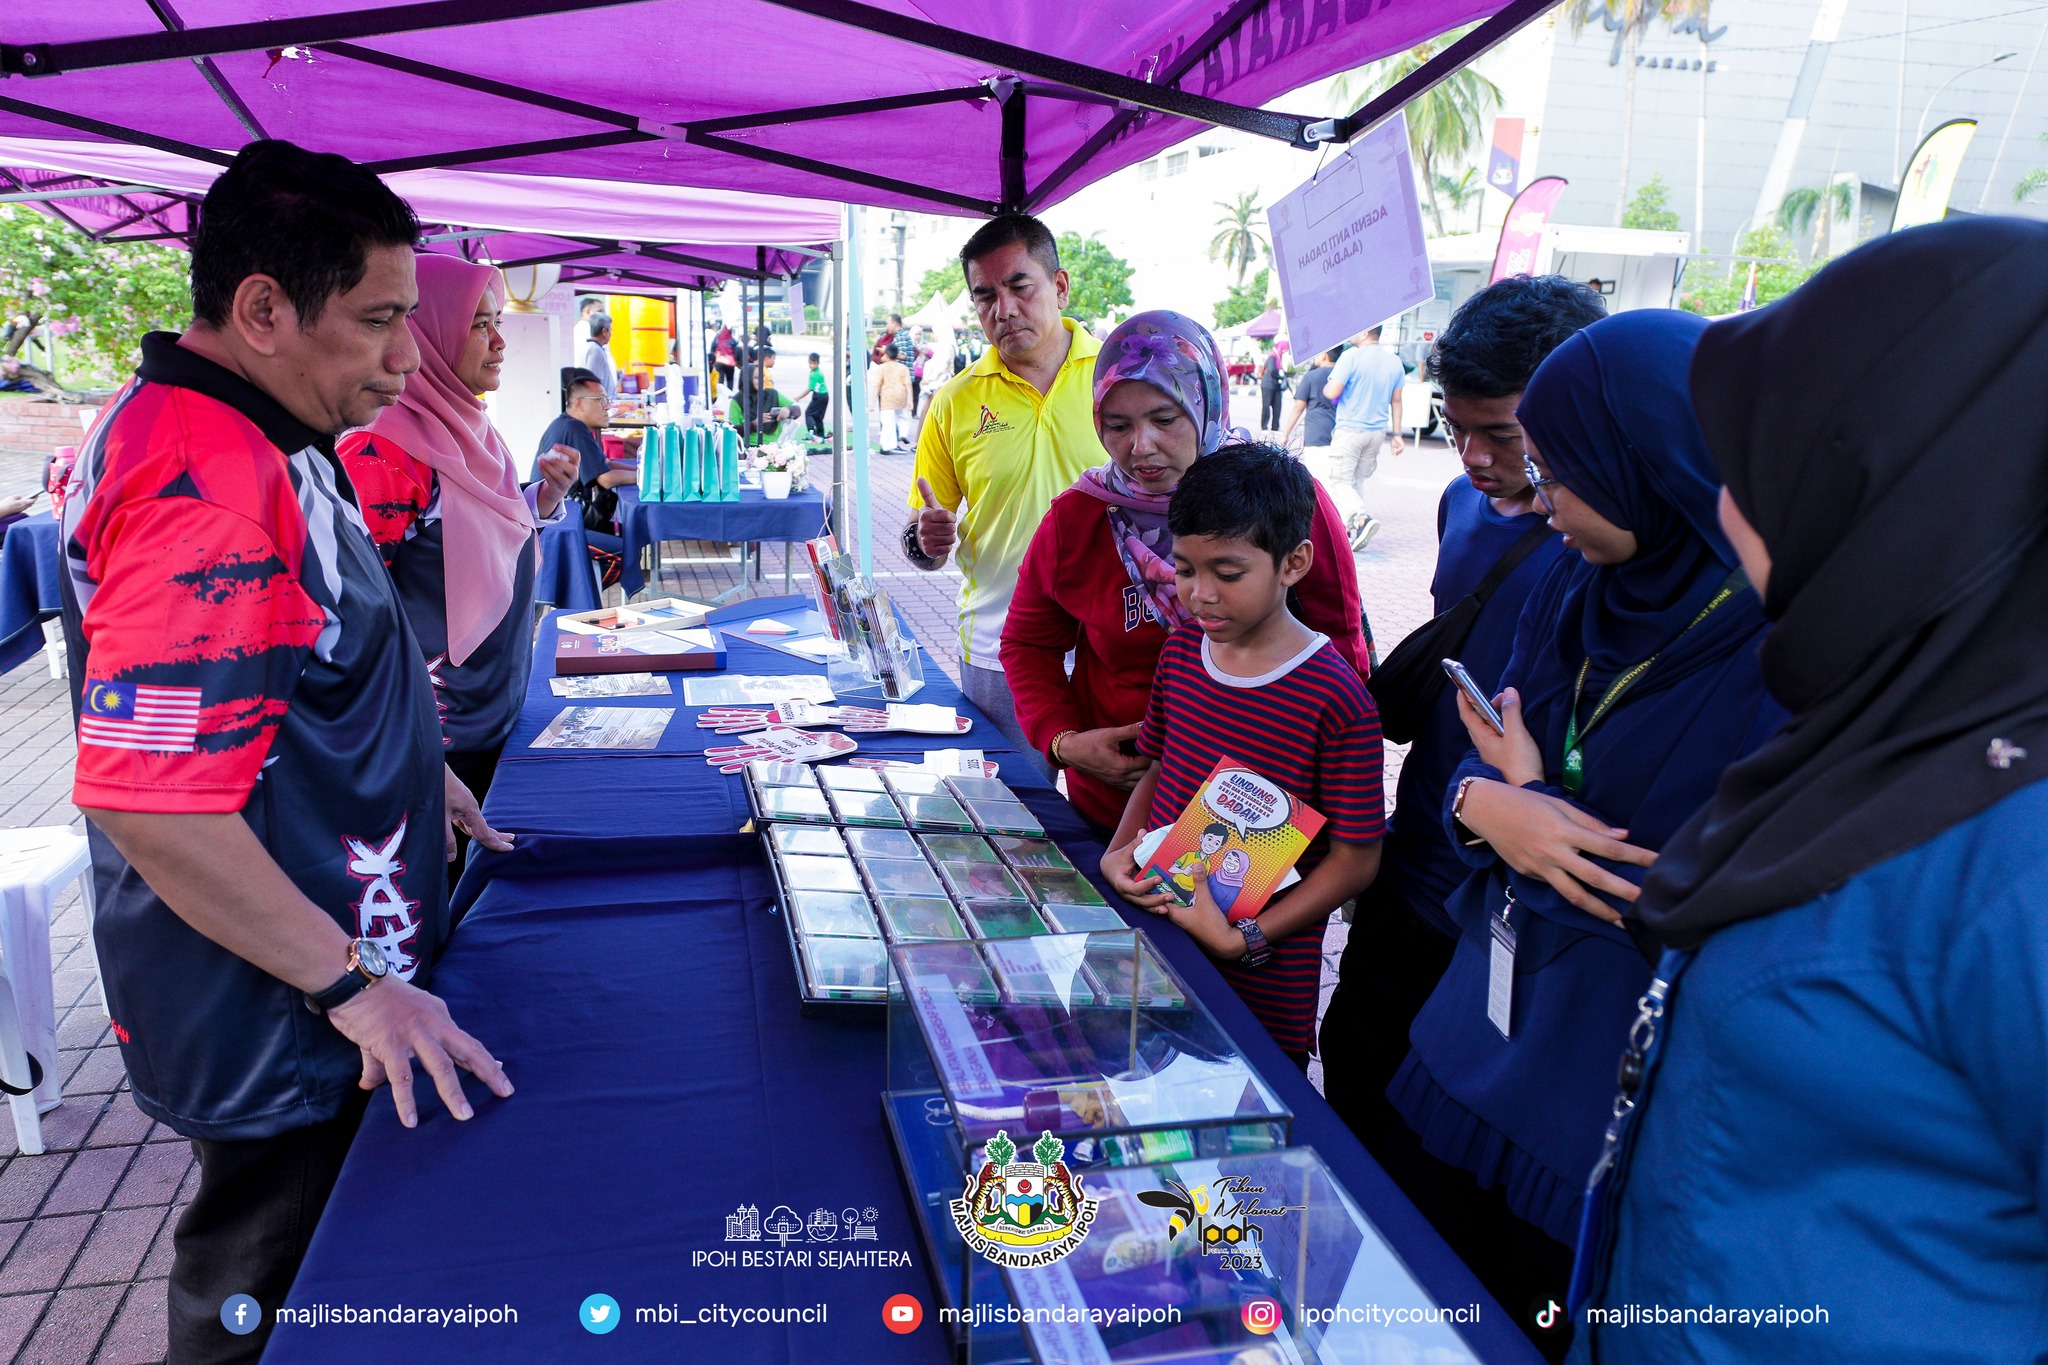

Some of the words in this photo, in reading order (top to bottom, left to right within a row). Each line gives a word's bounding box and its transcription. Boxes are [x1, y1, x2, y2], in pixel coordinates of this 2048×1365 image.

[1635, 55, 1717, 73] PARADE
[1708, 588, 1732, 609] SPINE
[1230, 774, 1278, 806] LINDUNGI
[1216, 793, 1261, 825] DADAH
[342, 813, 424, 985] ADK
